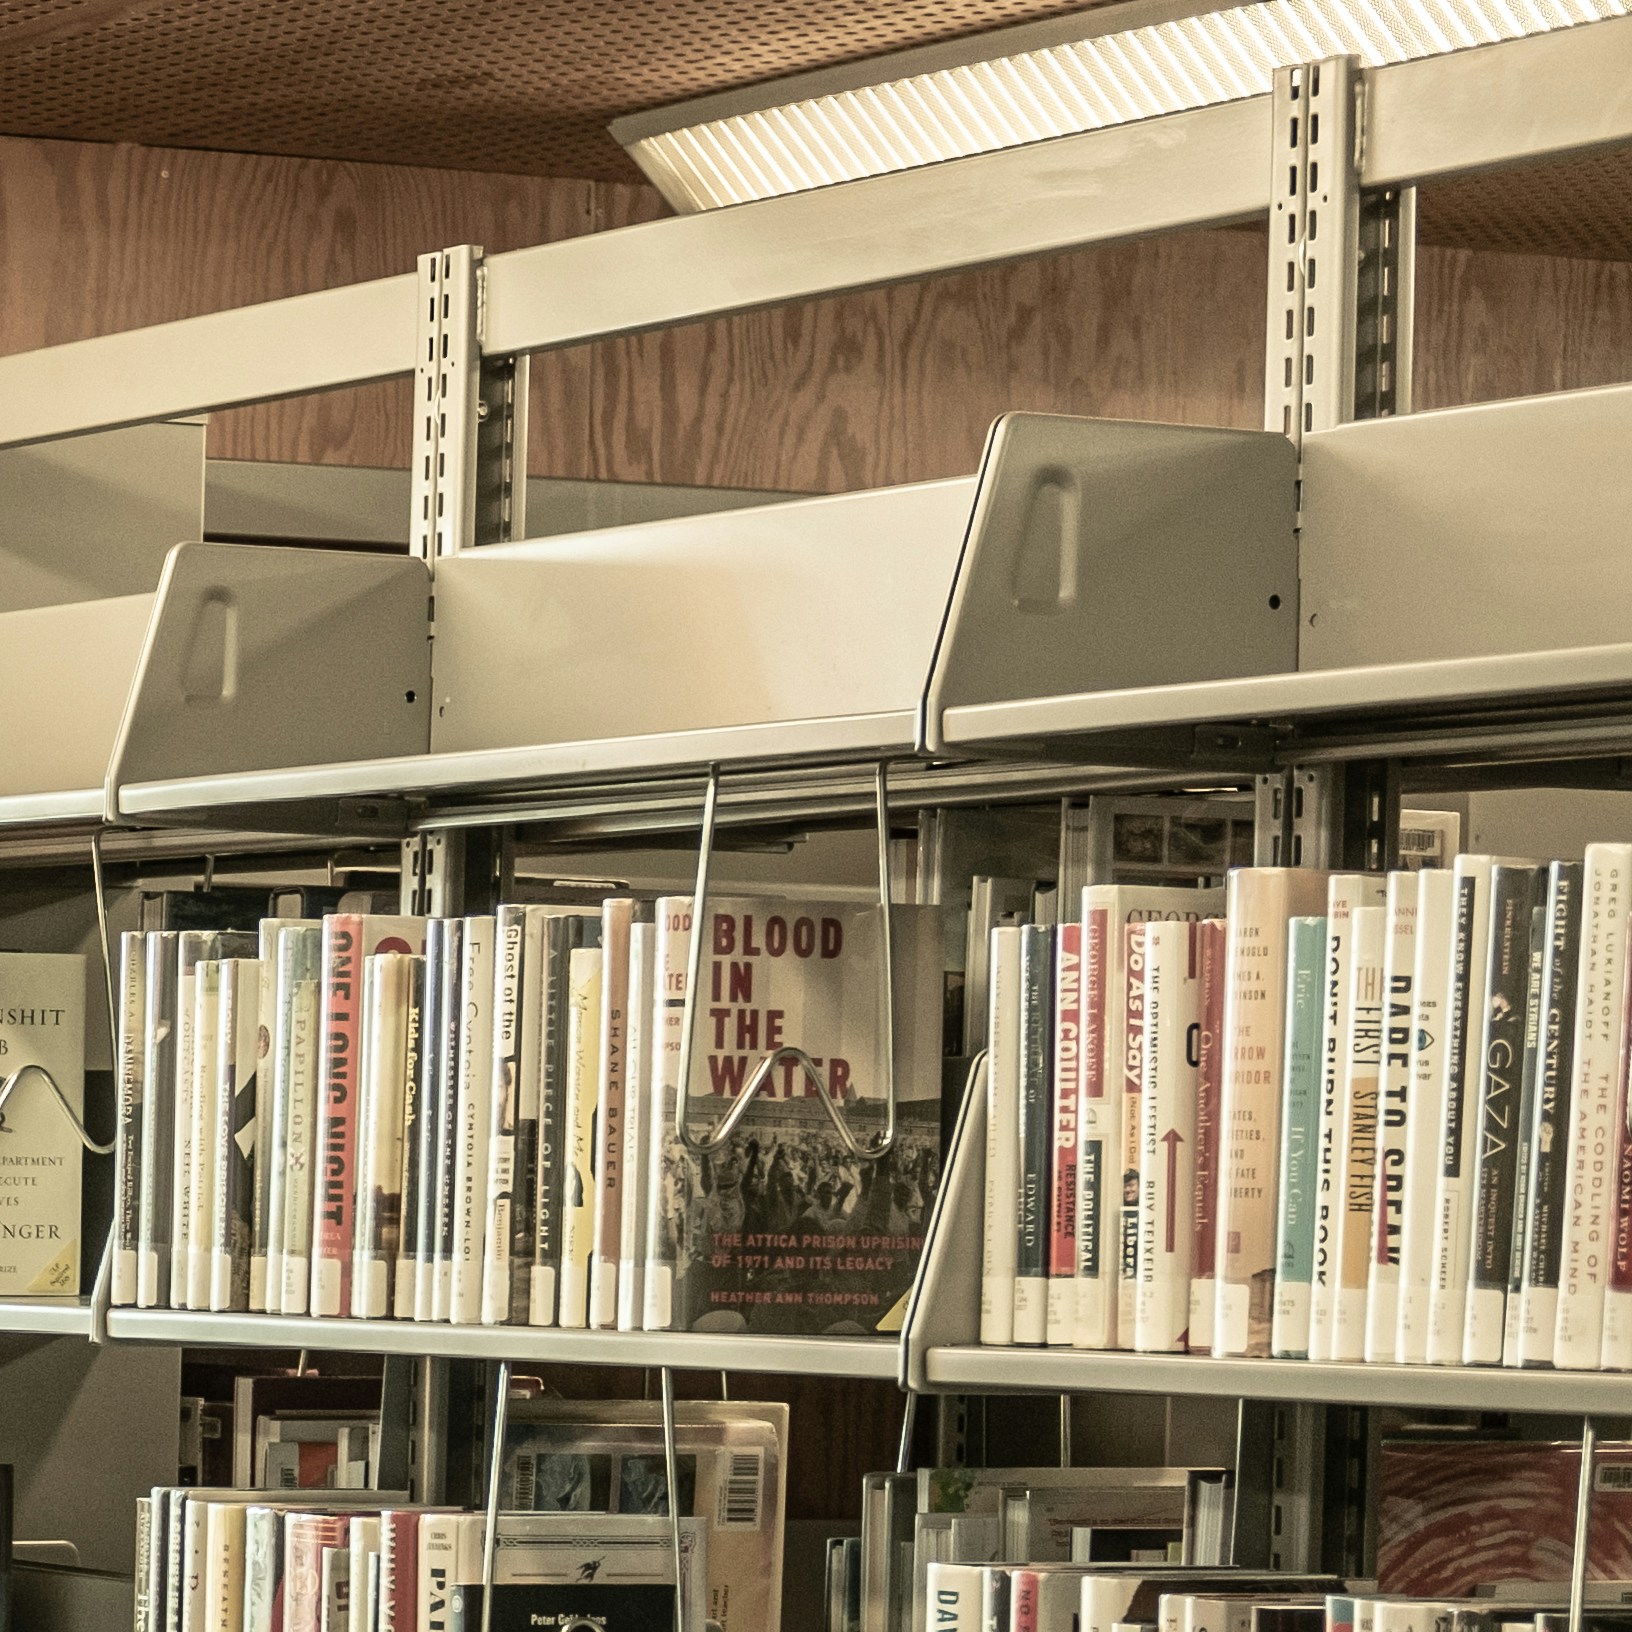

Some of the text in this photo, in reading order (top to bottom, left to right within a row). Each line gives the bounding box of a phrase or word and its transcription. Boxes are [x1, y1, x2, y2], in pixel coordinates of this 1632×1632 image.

[713, 914, 844, 957] BLOOD
[712, 961, 752, 1003] IN
[1541, 880, 1570, 1115] FIGHT CENTURY
[710, 1009, 785, 1050] THE
[1056, 951, 1080, 1149] ANN COULTER
[708, 1055, 851, 1098] WATER
[605, 1009, 621, 1190] SHANE BAUER
[1482, 1039, 1512, 1160] GAZA
[1349, 1091, 1378, 1213] STANLEY FISH
[714, 1233, 925, 1249] THE ATTICA PRISON UPRISIN
[712, 1256, 893, 1271] OF 1971 AND ITS LEGACY
[711, 1291, 879, 1306] HEATHER ANN THOMPSON
[531, 1614, 555, 1625] Peter
